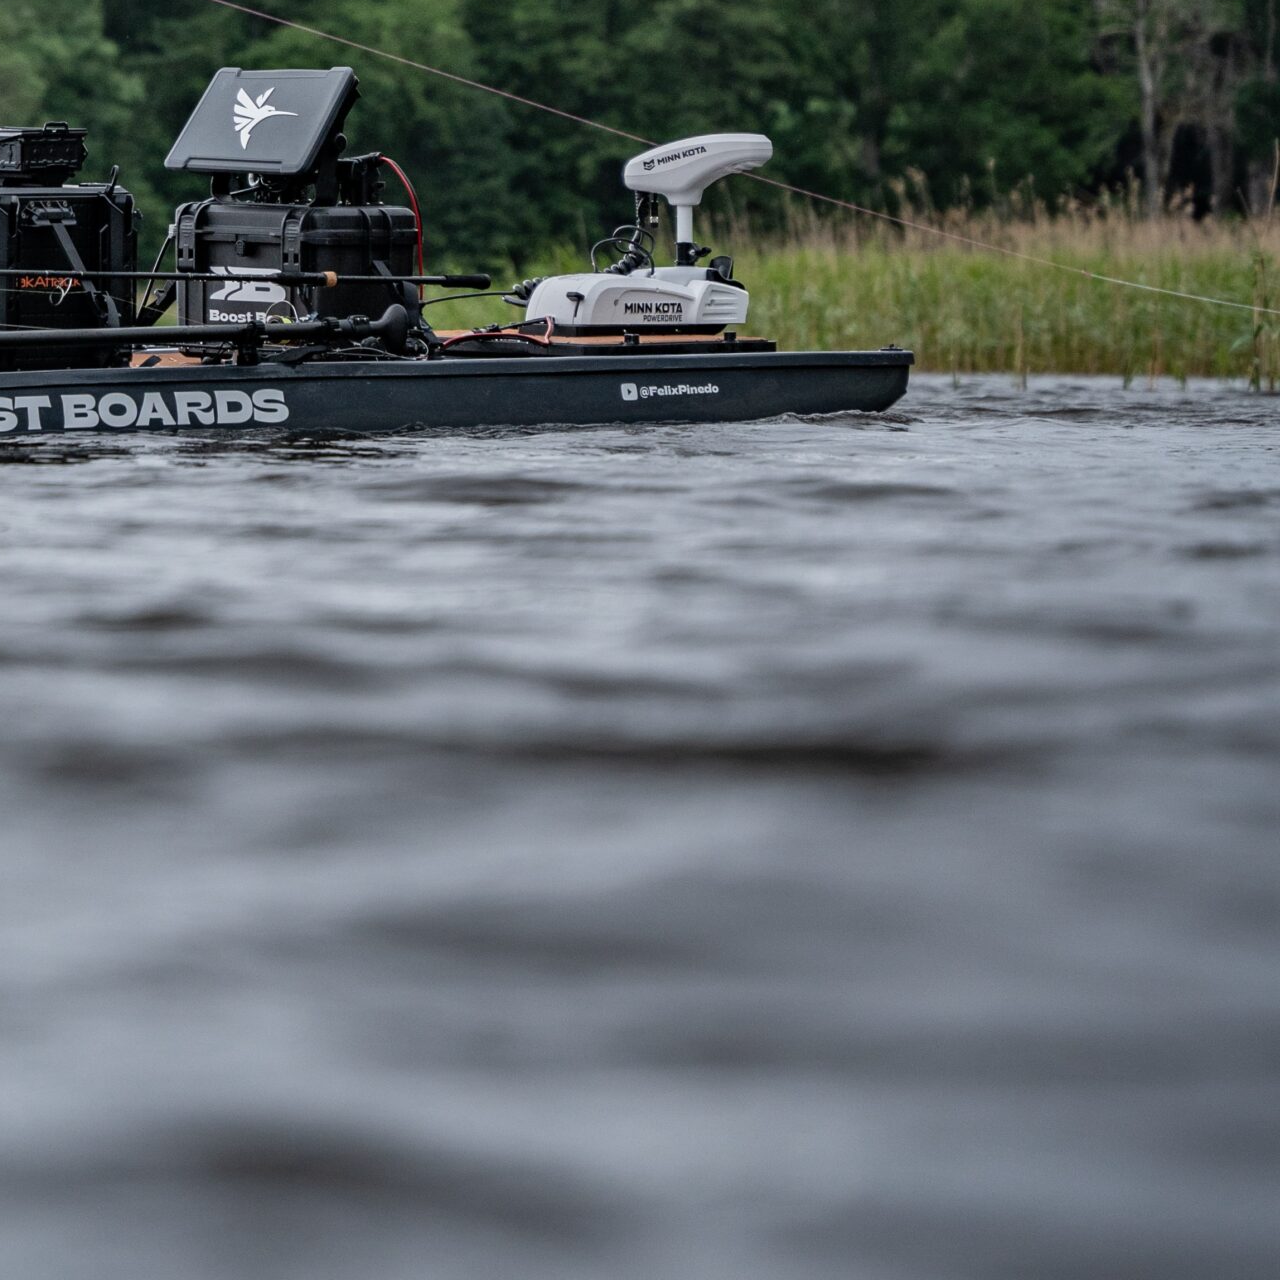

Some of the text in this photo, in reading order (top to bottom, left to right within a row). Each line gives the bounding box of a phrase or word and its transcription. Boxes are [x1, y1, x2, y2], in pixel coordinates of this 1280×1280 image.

[657, 146, 707, 166] MINN KOTA
[624, 303, 683, 314] MINN KOTA
[209, 309, 254, 323] Boost
[640, 384, 719, 398] @FelixPinedo
[60, 389, 290, 429] BOARDS
